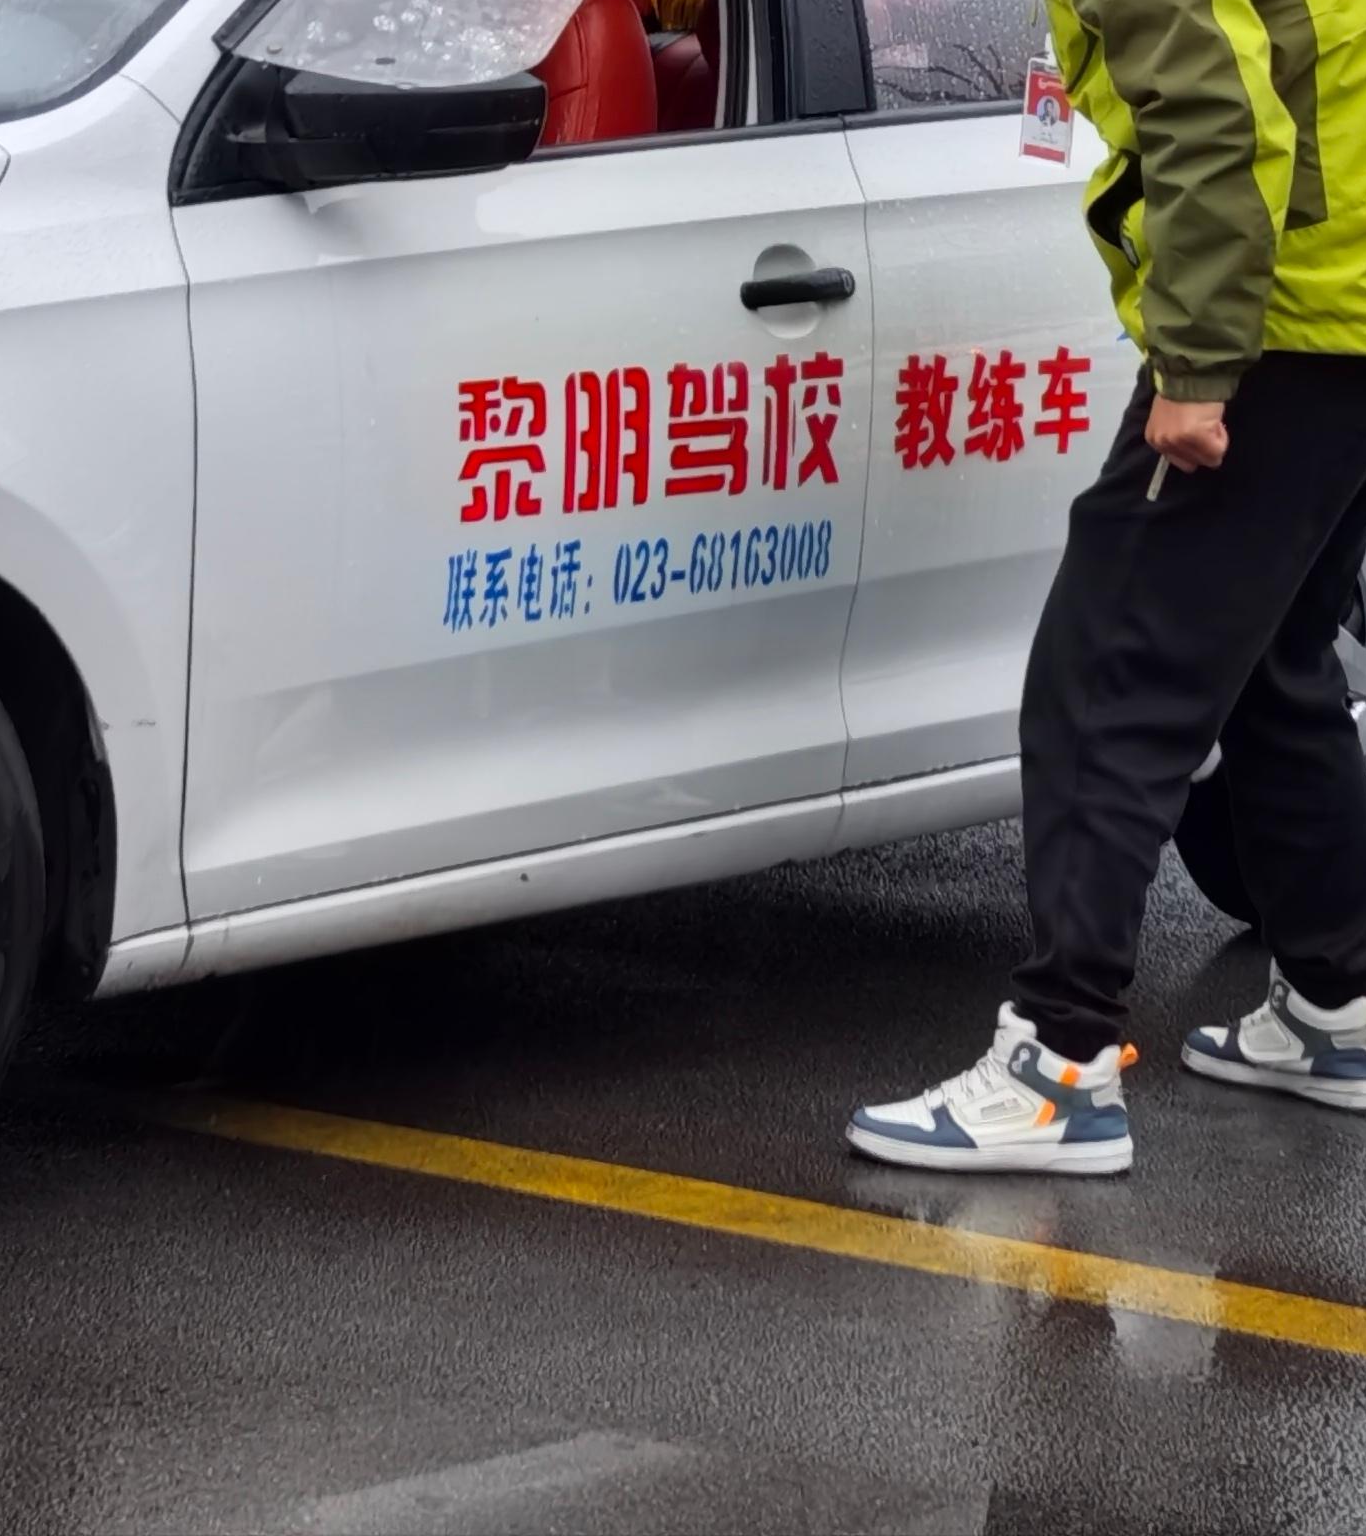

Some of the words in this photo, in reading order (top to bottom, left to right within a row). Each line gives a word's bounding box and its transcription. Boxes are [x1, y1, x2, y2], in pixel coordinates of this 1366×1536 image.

[457, 351, 845, 523] 黎明驾校
[894, 346, 1091, 469] 教练车
